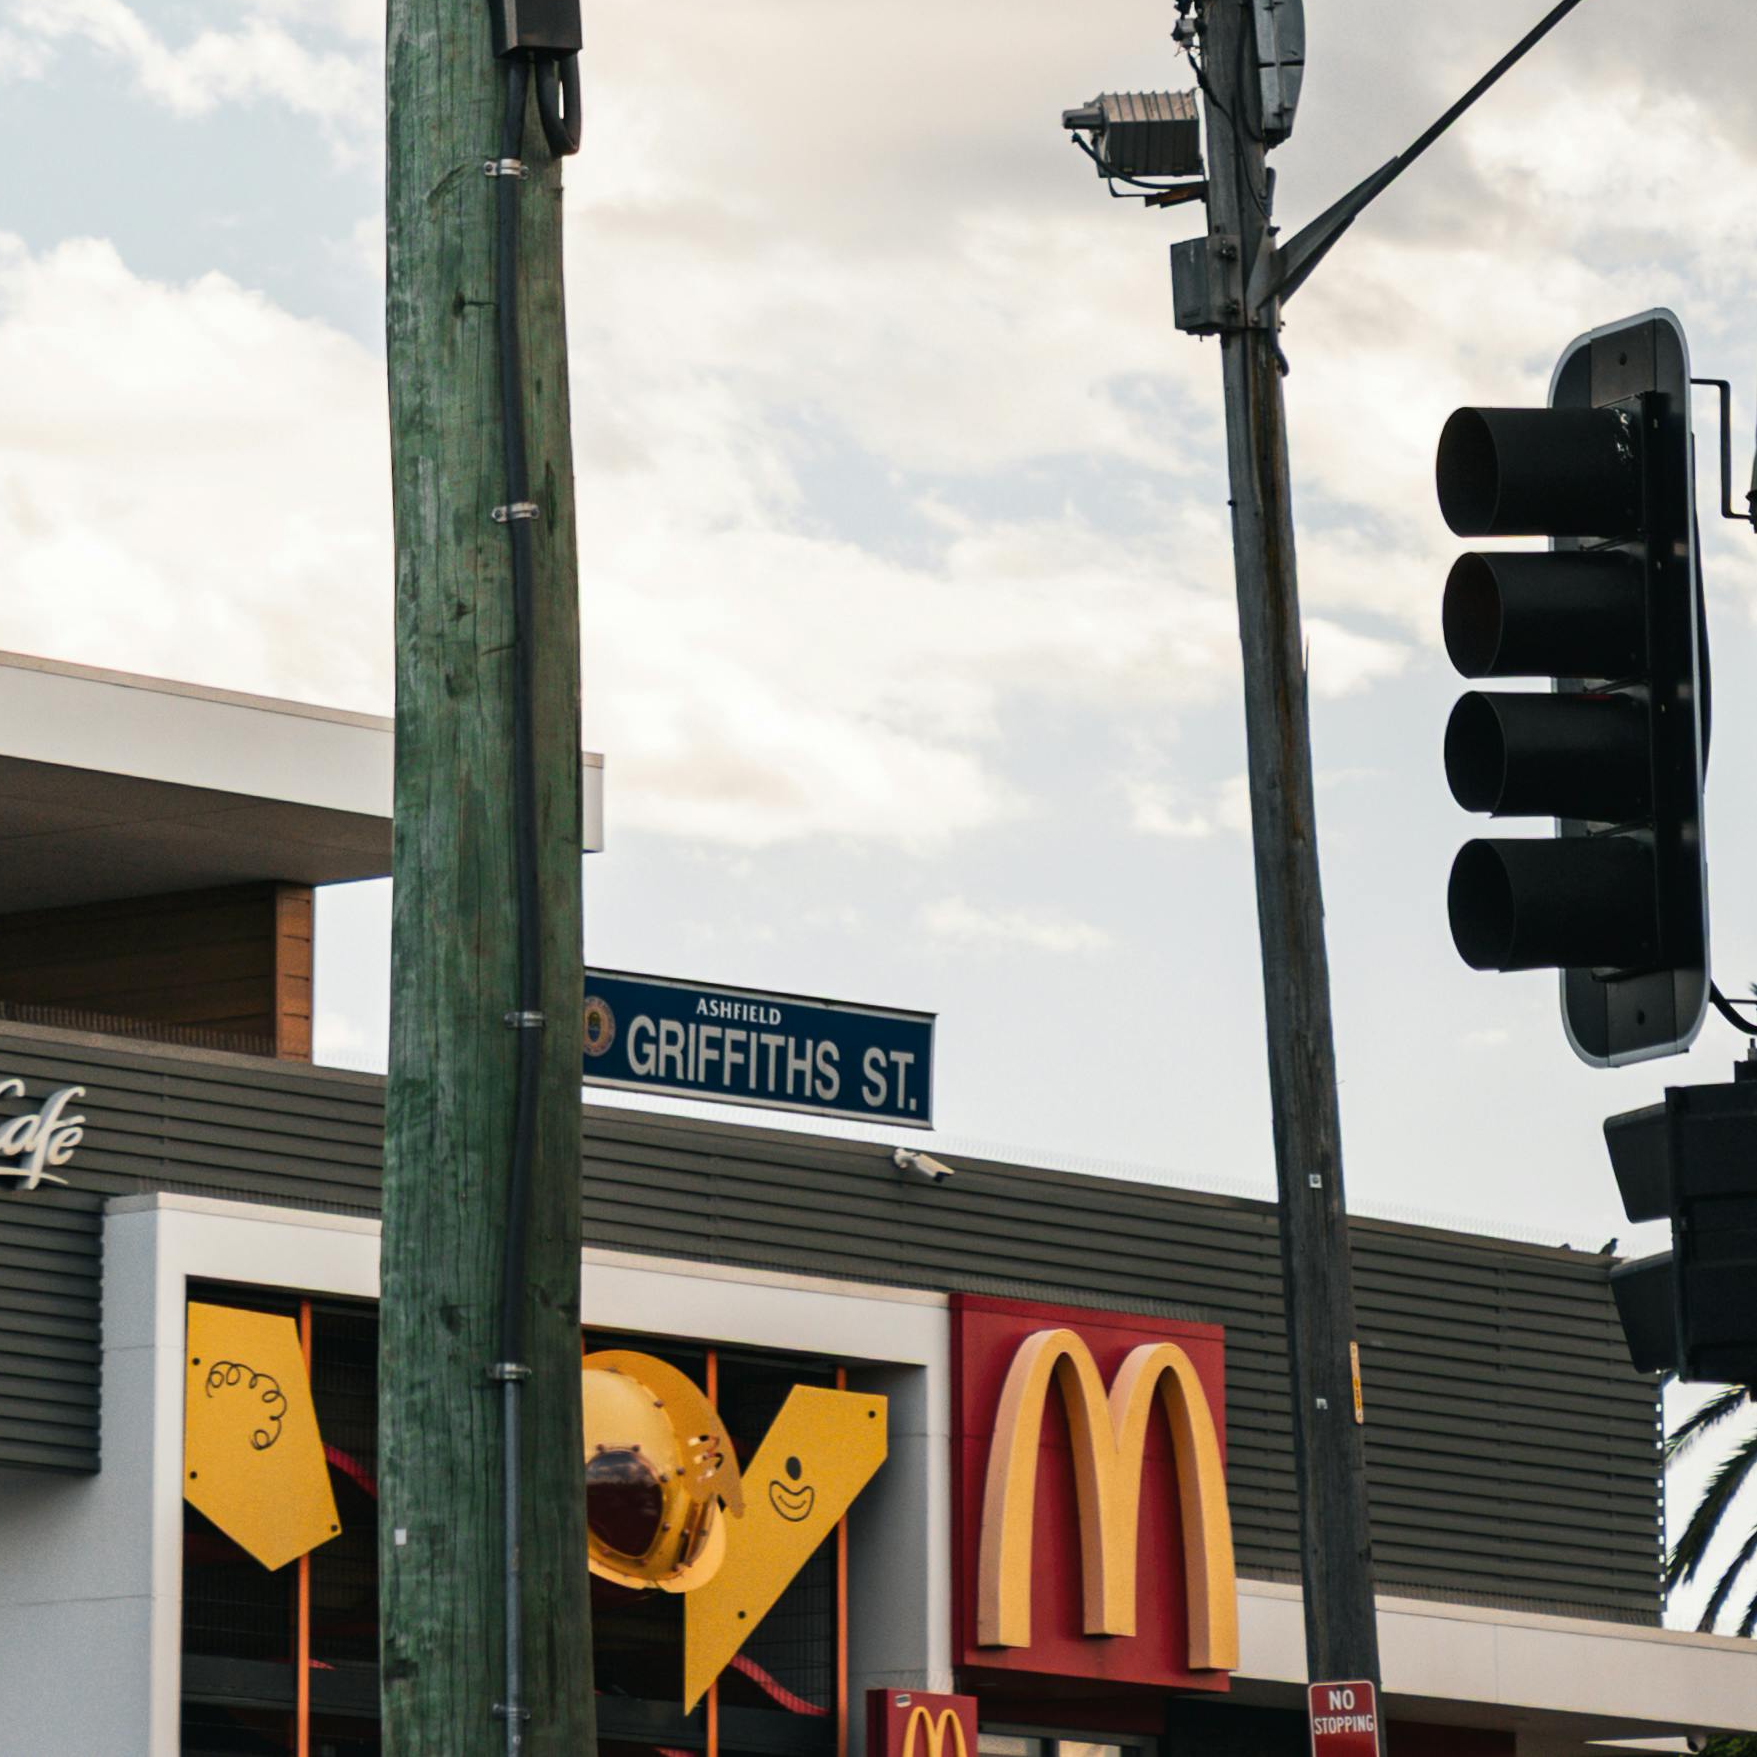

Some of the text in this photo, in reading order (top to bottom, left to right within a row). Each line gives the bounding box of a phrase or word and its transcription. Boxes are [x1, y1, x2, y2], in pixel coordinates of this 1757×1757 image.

[695, 998, 783, 1026] ASHFIELD
[626, 1014, 841, 1101] GRIFFITHS
[861, 1046, 918, 1112] ST.
[1329, 1689, 1356, 1711] NO
[1314, 1714, 1375, 1735] STOPPING
